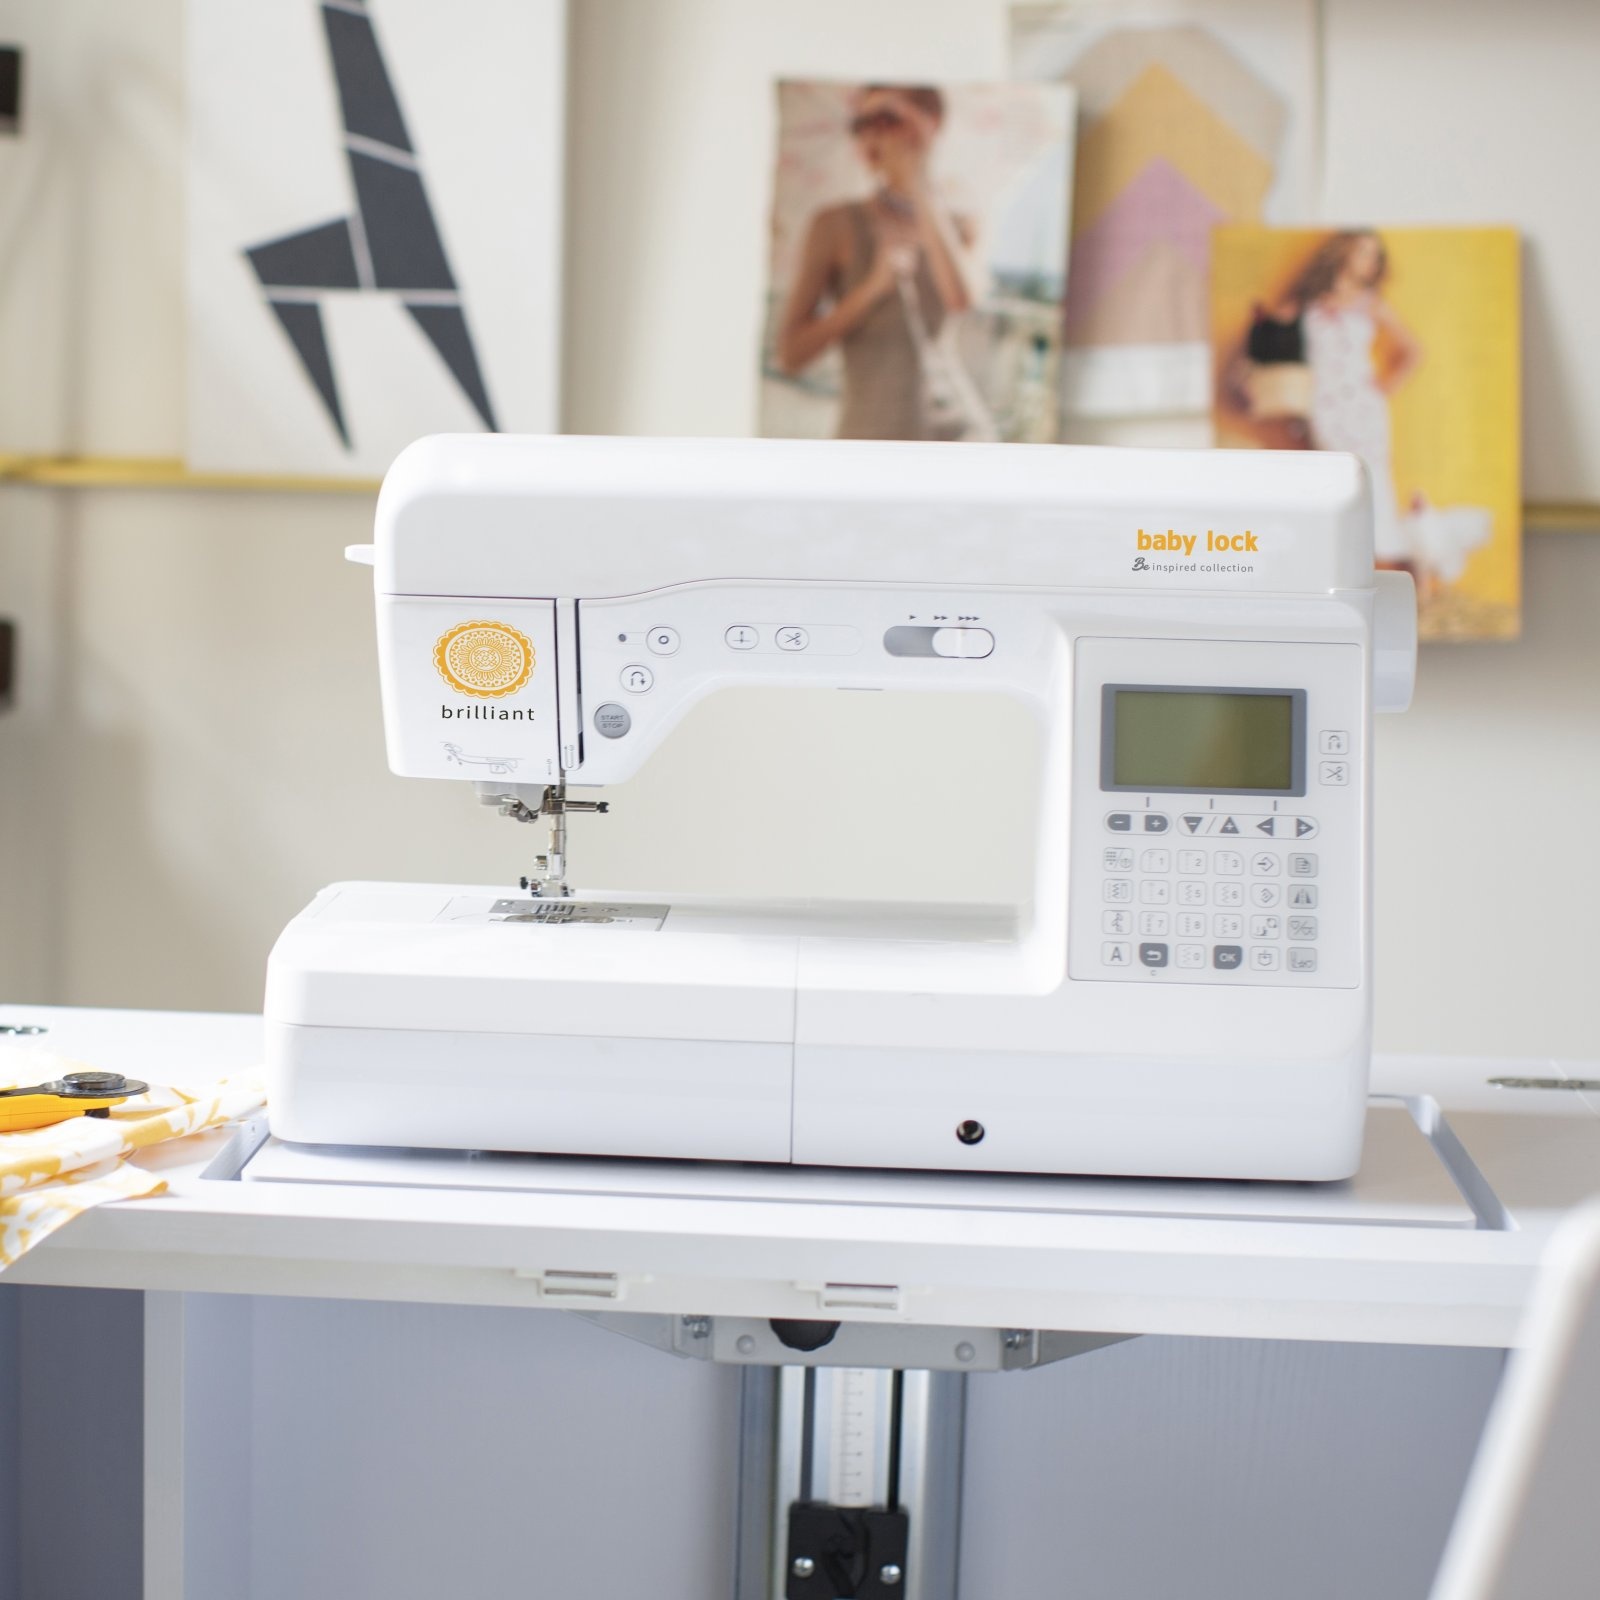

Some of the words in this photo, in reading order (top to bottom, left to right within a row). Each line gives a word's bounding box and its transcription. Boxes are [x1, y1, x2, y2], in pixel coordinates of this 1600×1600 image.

[1137, 529, 1197, 556] baby
[1207, 530, 1259, 552] lock
[1132, 557, 1150, 571] Be
[1152, 563, 1196, 573] inspired
[1200, 563, 1254, 573] collection
[441, 705, 535, 720] brilliant
[1195, 858, 1202, 867] 2
[1232, 859, 1239, 868] 3
[1157, 888, 1164, 897] 4
[1195, 889, 1202, 898] 5
[1232, 890, 1239, 899] 6
[1157, 920, 1164, 928] 7
[1110, 946, 1123, 962] A
[1219, 953, 1236, 962] OK
